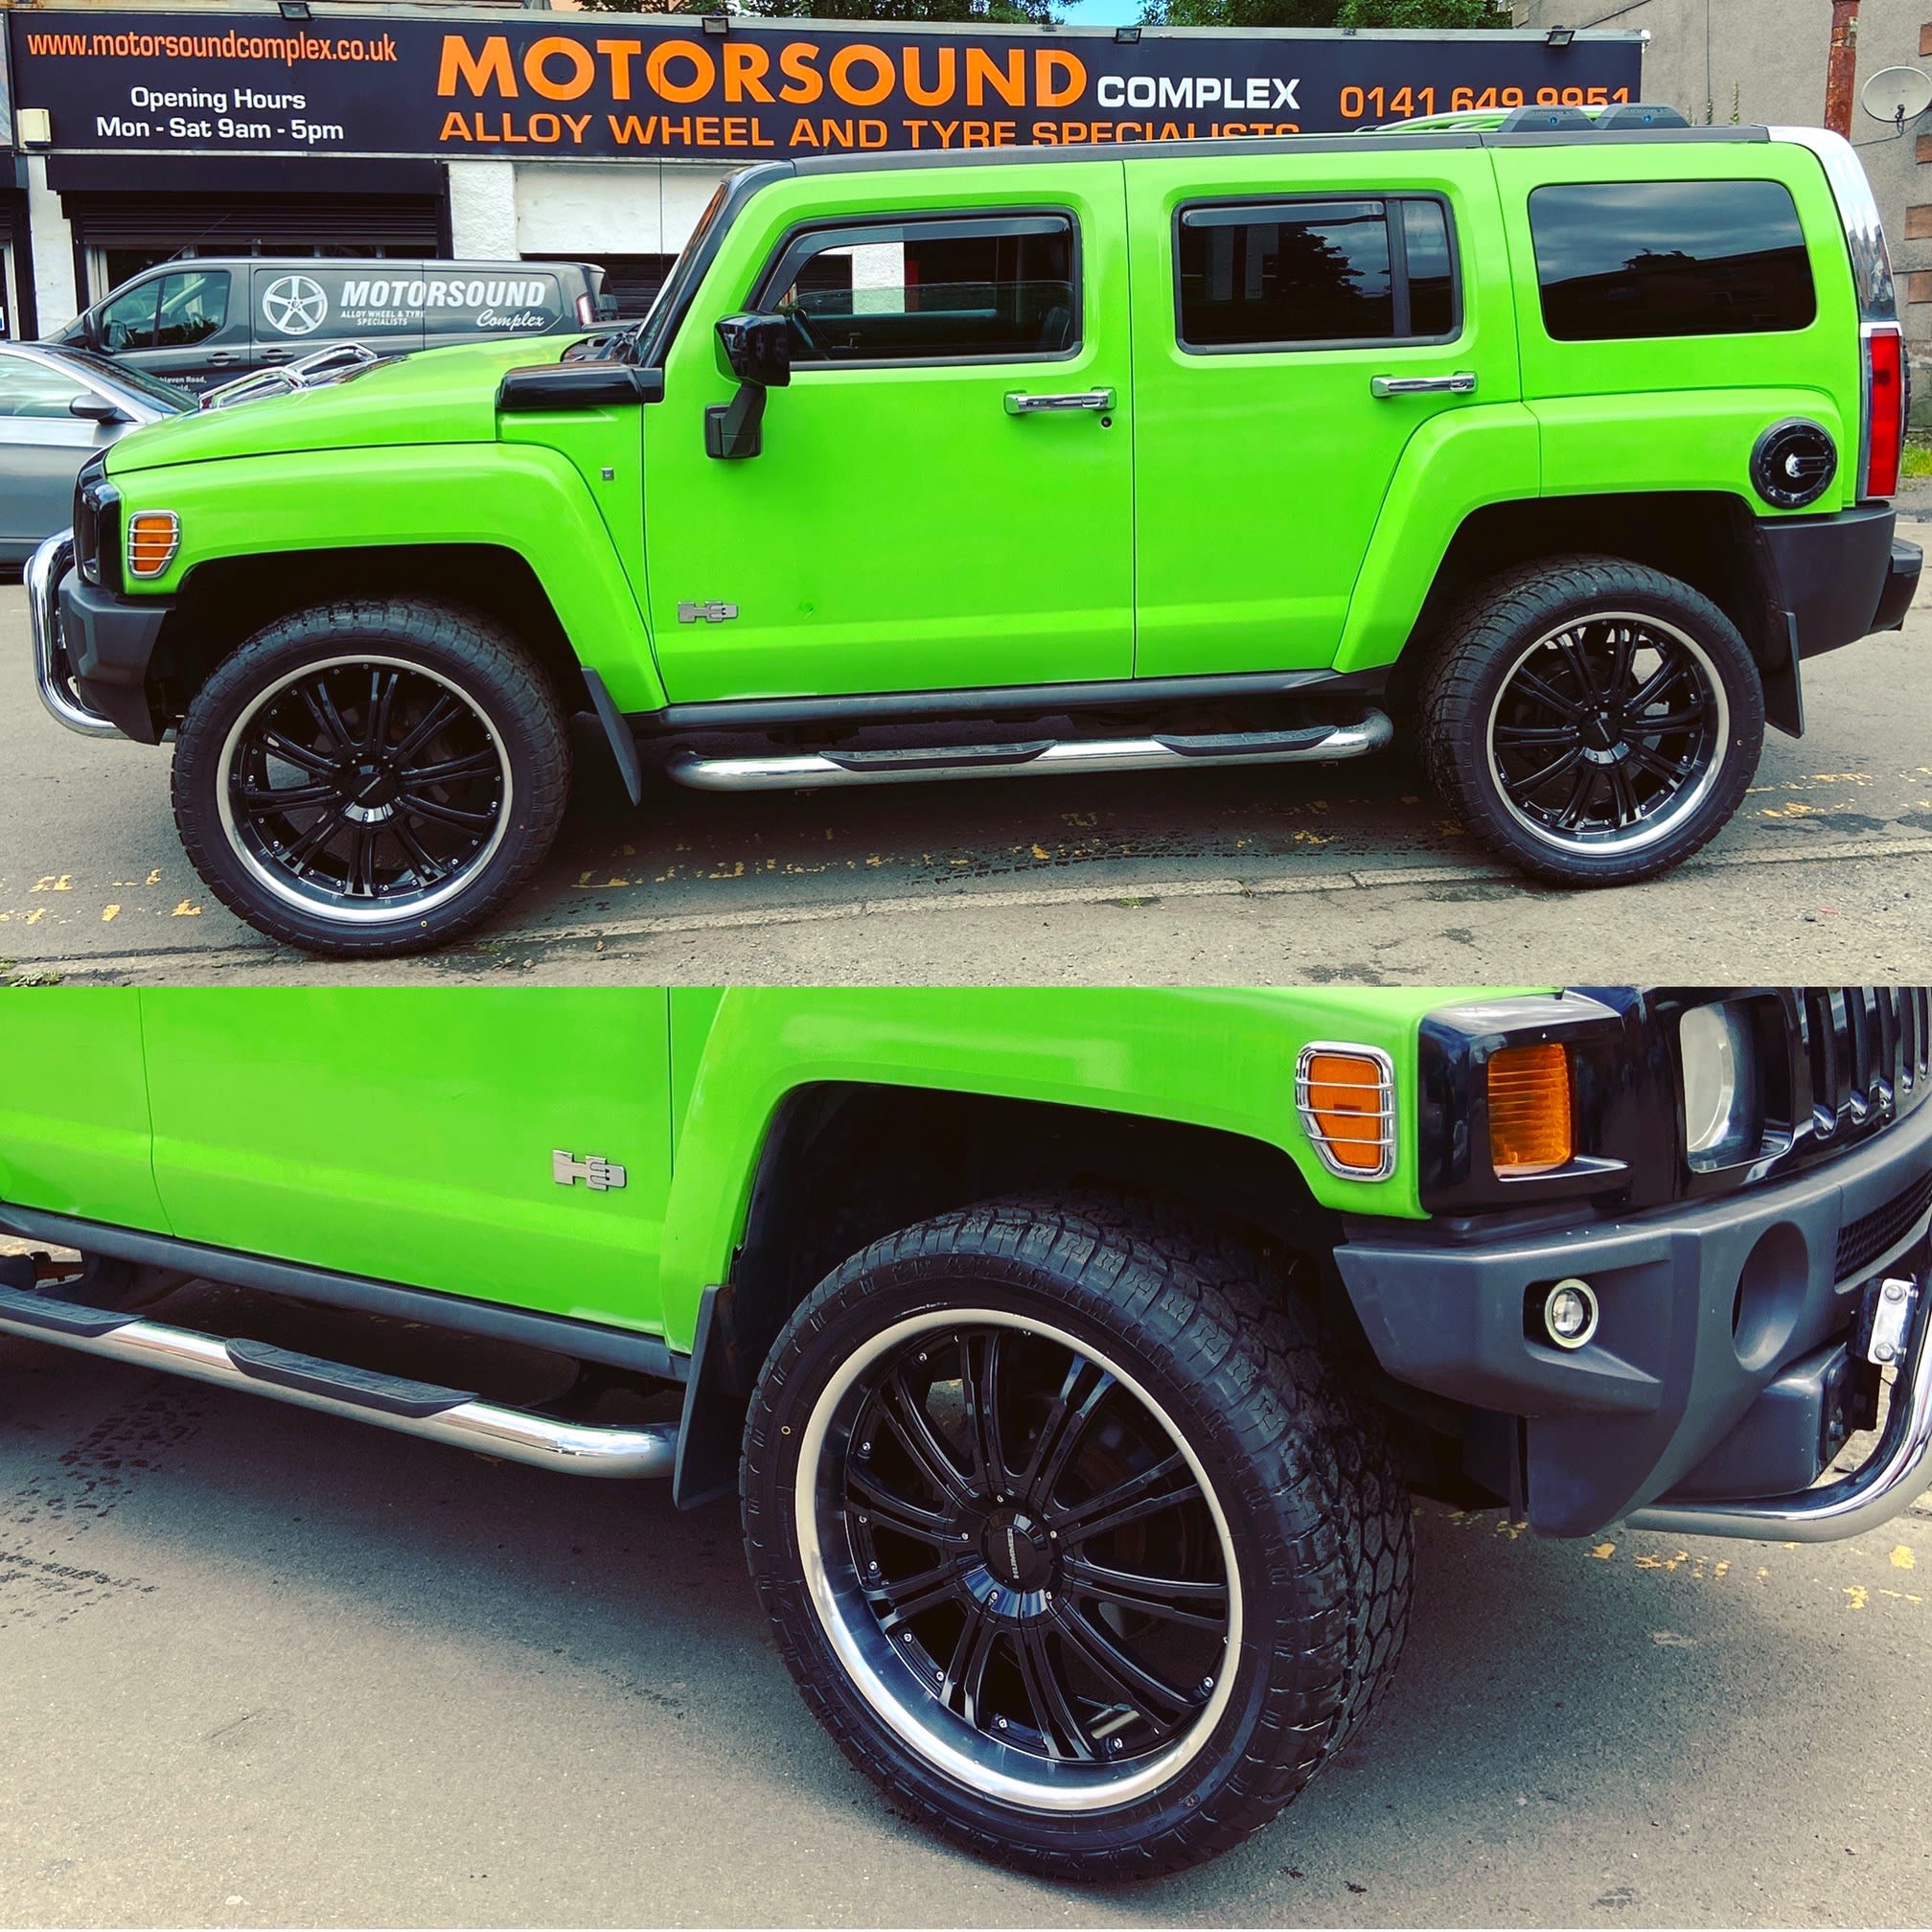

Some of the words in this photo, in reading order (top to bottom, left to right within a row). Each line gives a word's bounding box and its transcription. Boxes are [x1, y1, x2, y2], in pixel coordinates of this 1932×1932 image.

[28, 30, 397, 67] www.motorsoundcomplex.co.uk
[437, 34, 1088, 108] MOTORSOUND
[1097, 76, 1301, 110] COMPLEX
[130, 86, 228, 111] Opening
[234, 88, 307, 109] Hours
[1340, 86, 1436, 117] 0141
[1451, 87, 1524, 108] 649
[1536, 87, 1630, 106] 9951
[97, 117, 150, 138] Mon
[170, 117, 212, 138] Sat
[218, 118, 271, 139] 9am
[291, 119, 344, 144] 5pm
[439, 112, 592, 144] ALLOY
[608, 115, 775, 147] WHEEL
[789, 118, 887, 149] AND
[903, 120, 1017, 149] TYRE
[340, 280, 545, 308] MOTORSOUND
[340, 310, 367, 318] ALLOY
[368, 310, 395, 318] WHEEL
[397, 310, 403, 318] &
[405, 310, 426, 318] TYRE
[476, 309, 545, 332] Complex
